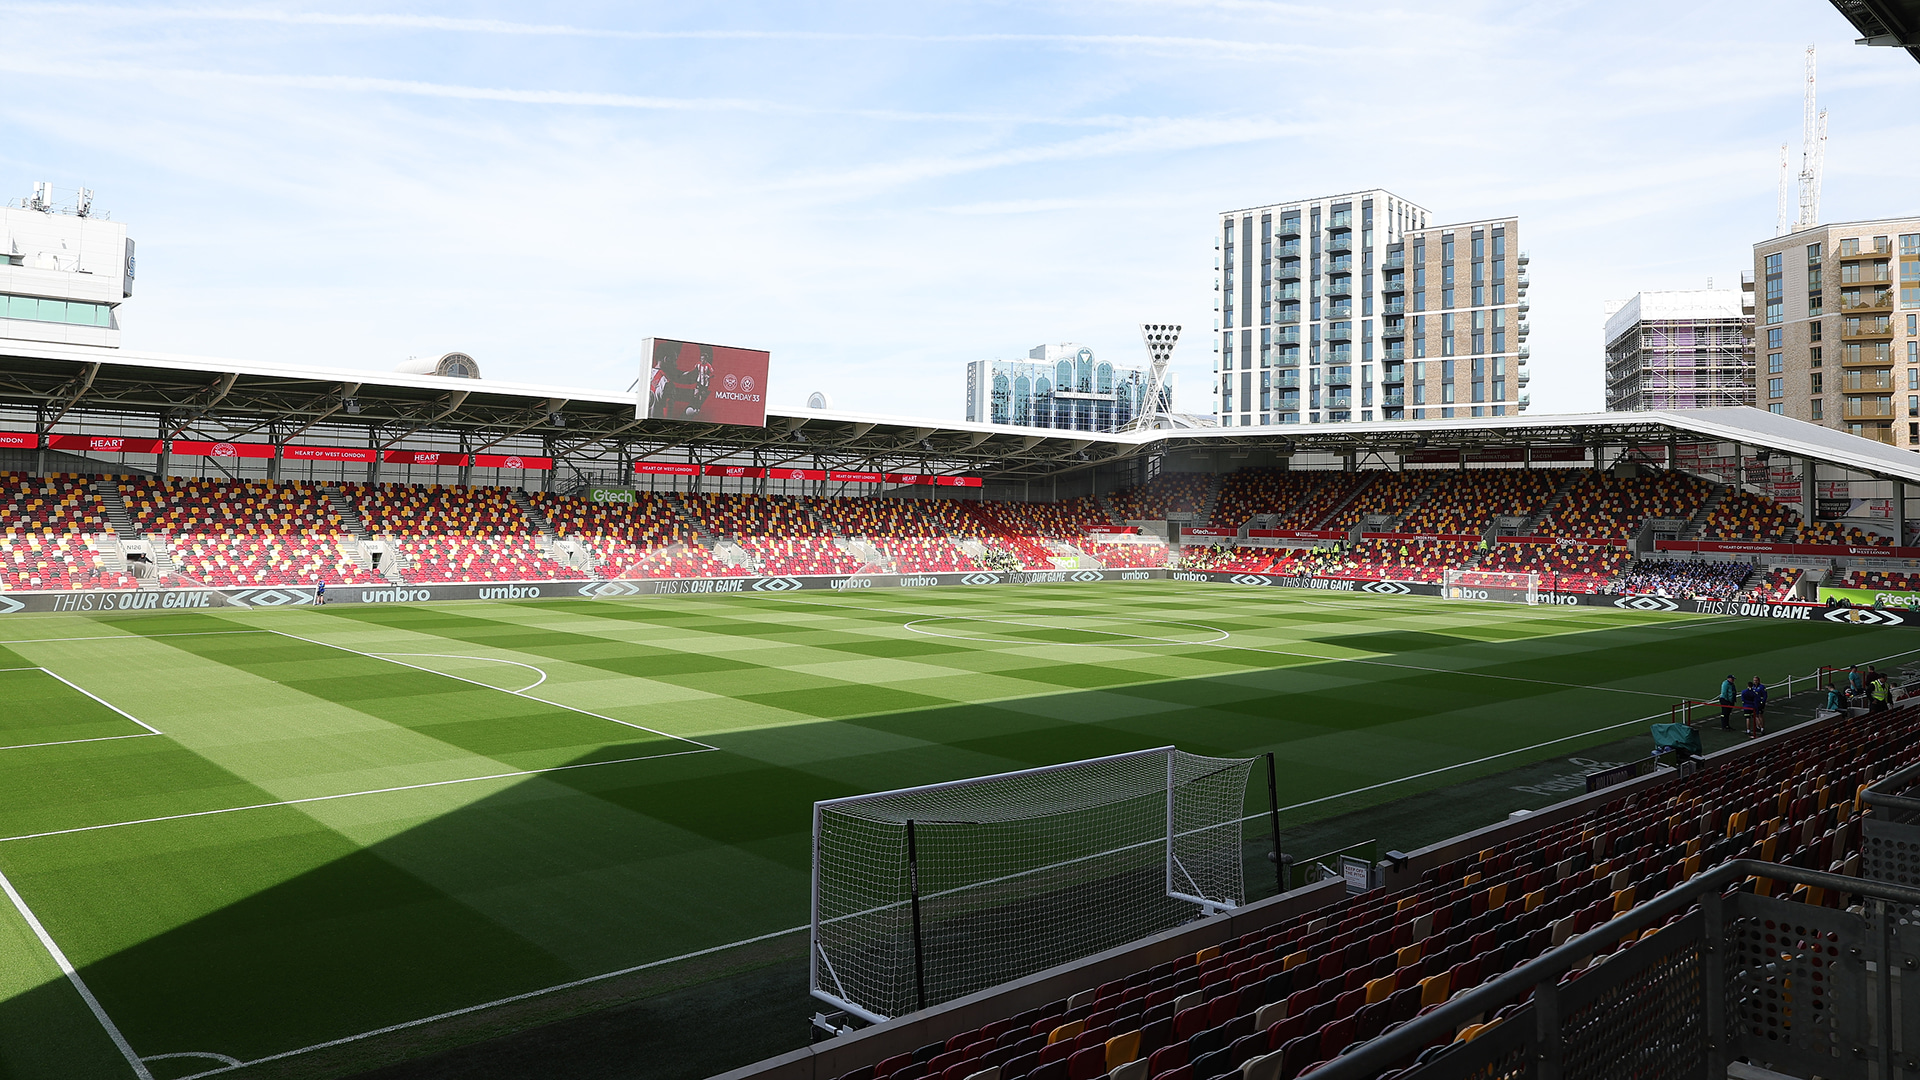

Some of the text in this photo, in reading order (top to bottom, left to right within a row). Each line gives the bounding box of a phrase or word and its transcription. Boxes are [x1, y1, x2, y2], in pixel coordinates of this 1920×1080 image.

[715, 391, 760, 402] MATCHDAY 33
[90, 439, 124, 448] HEART
[414, 453, 440, 461] HEART
[593, 489, 633, 502] Gtech
[900, 575, 938, 587] umbro
[1008, 571, 1066, 583] THIS IS OUR GAME
[1121, 570, 1149, 580] umbro
[1173, 571, 1207, 582] umbro
[654, 579, 744, 594] THIS IS OUR GAME
[830, 577, 872, 589] umbro
[1282, 577, 1355, 591] THIS IS OUR GAME
[361, 587, 431, 603] umbro
[479, 584, 540, 600] umbro
[1525, 591, 1578, 606] umbro
[53, 591, 213, 612] THIS IS OUR GAME
[1875, 592, 1920, 606] Gtech
[1696, 600, 1813, 620] THIS IS OUR GAME
